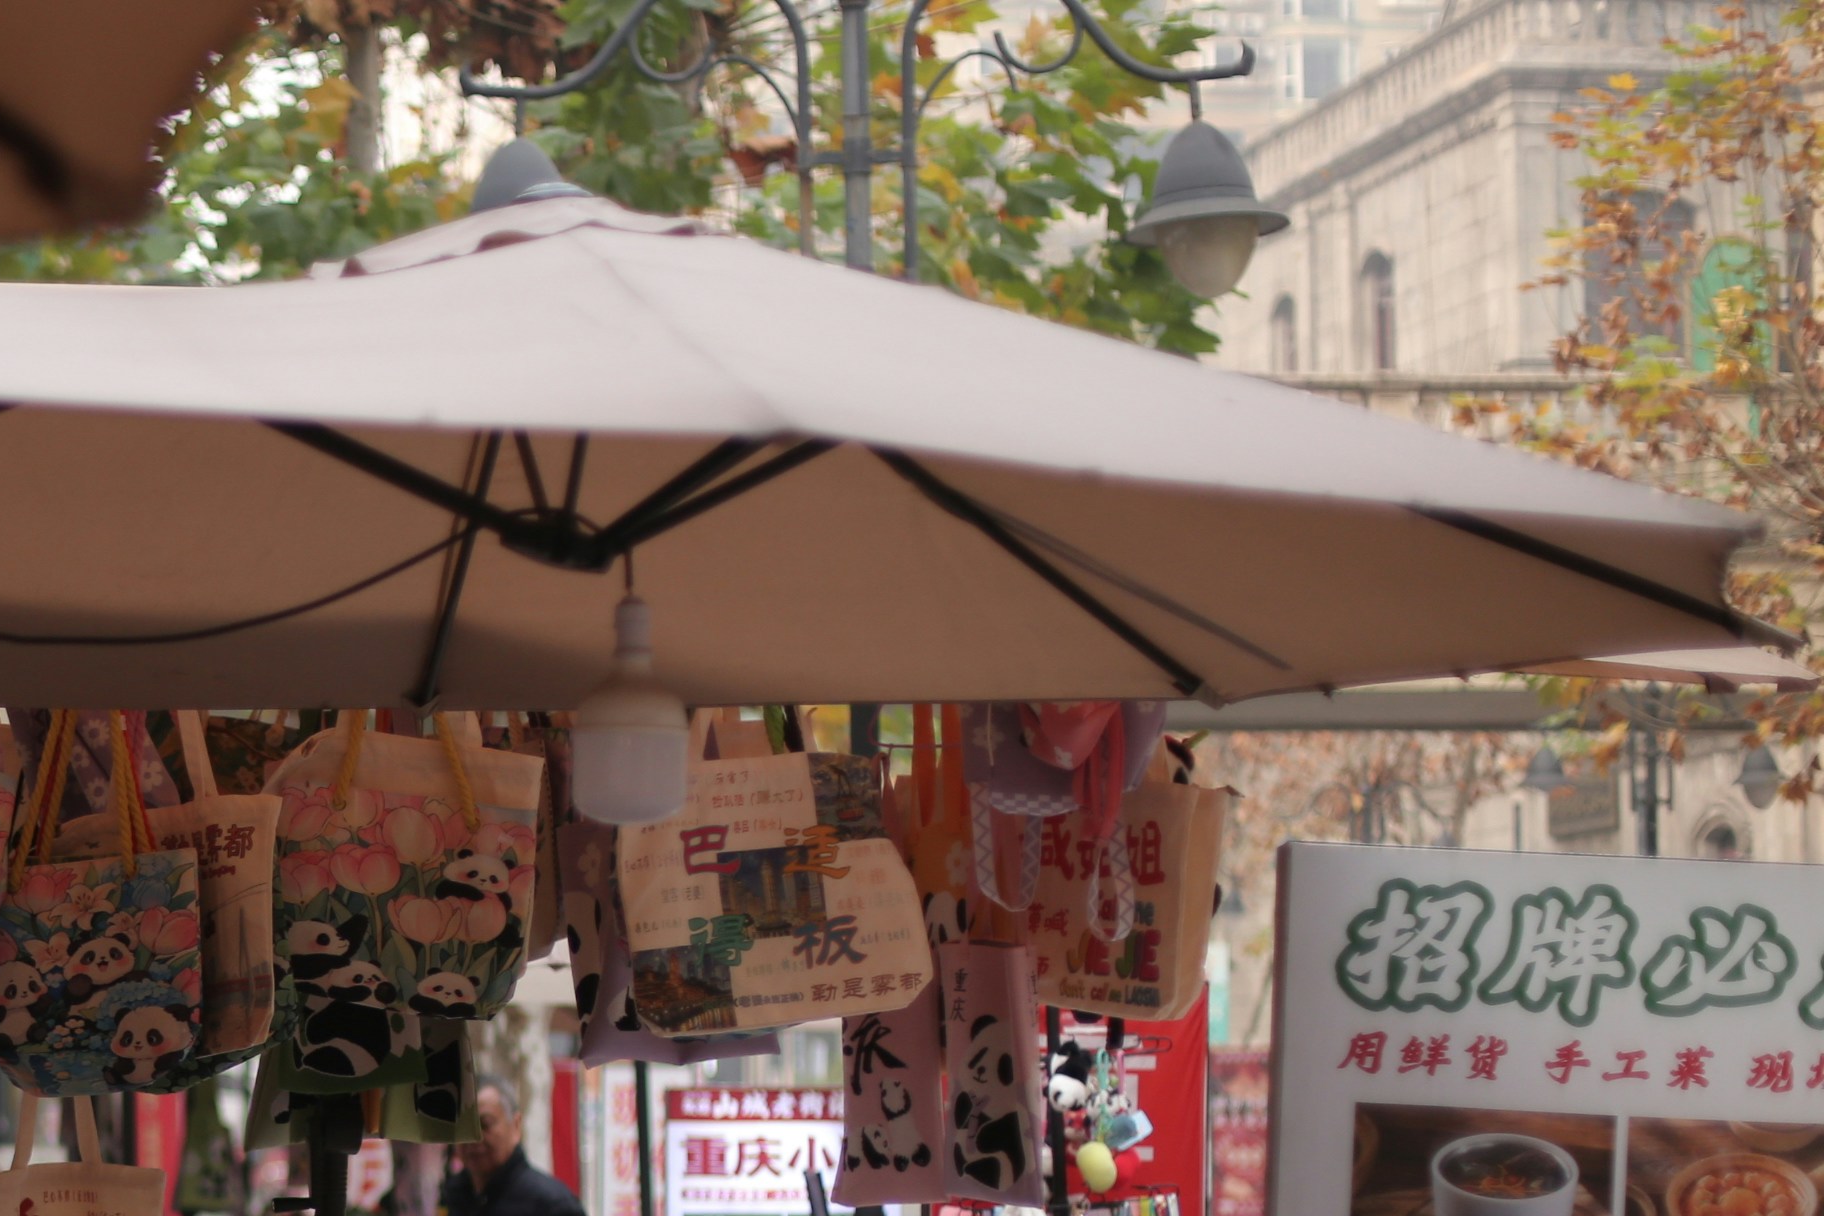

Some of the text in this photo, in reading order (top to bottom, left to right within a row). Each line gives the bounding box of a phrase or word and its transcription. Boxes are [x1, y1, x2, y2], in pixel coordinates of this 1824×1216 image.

[1335, 878, 1824, 1031] 招牌必
[811, 972, 923, 1003] 勒是雾都
[1337, 1031, 1509, 1081] 用鲜货
[1545, 1039, 1715, 1091] 手工菜
